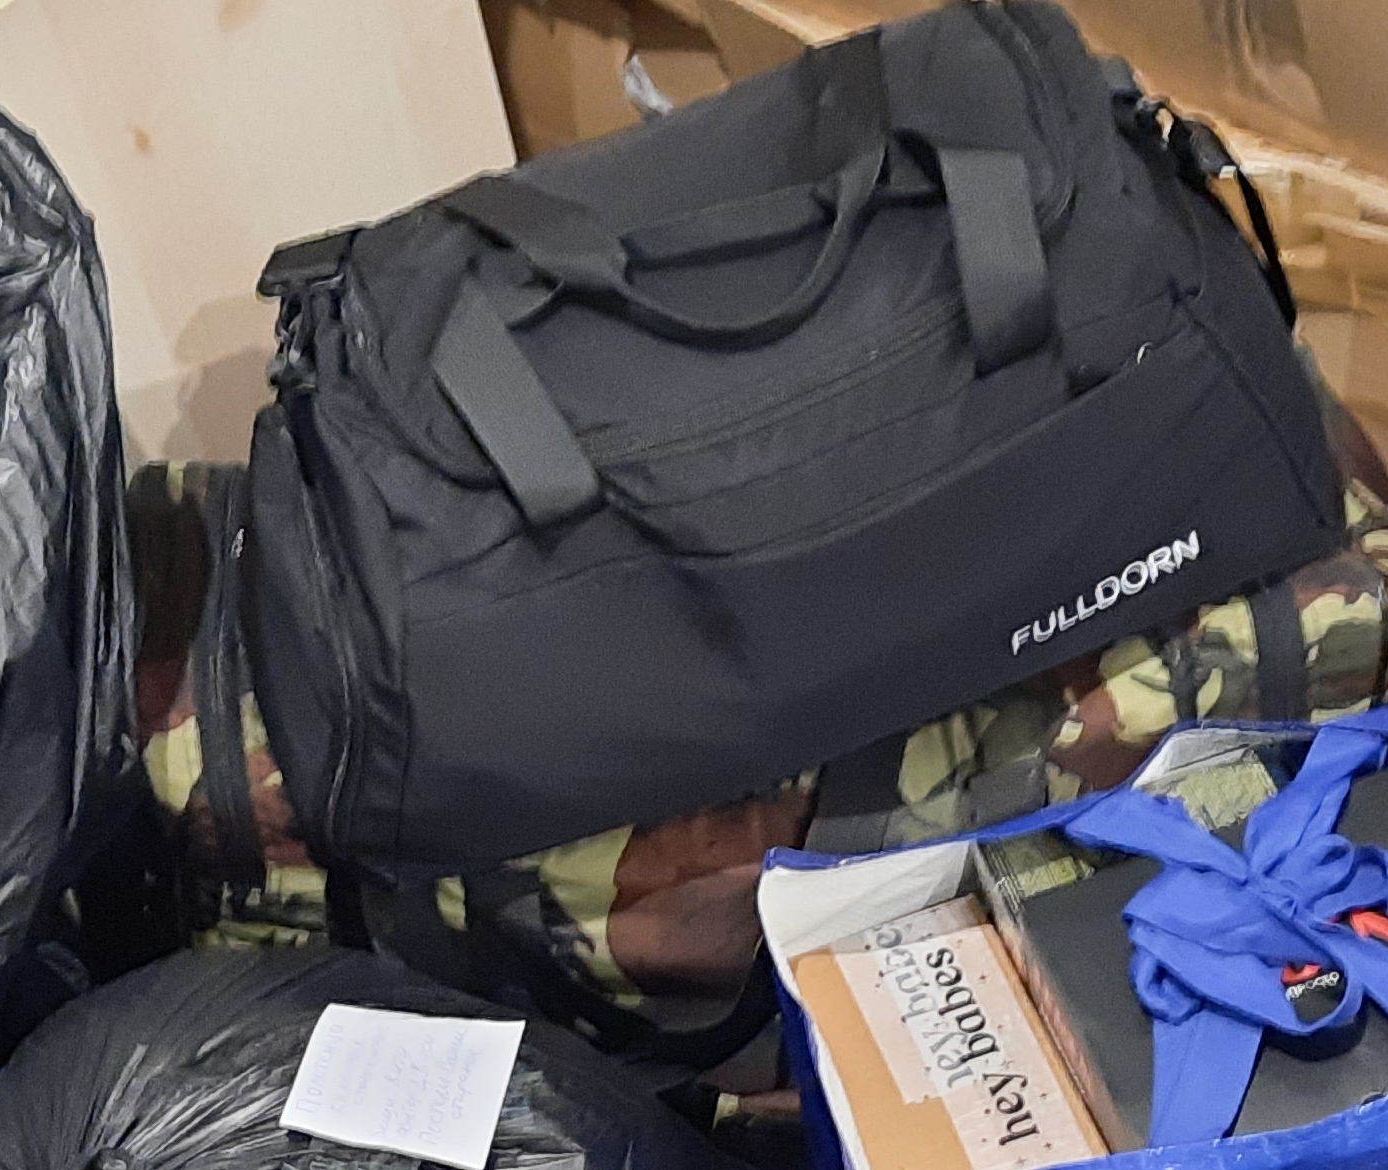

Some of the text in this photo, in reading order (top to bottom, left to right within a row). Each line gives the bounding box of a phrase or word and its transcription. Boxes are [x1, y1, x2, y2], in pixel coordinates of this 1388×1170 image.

[1011, 529, 1201, 656] FULLDORN
[925, 946, 1041, 1147] hey babes
